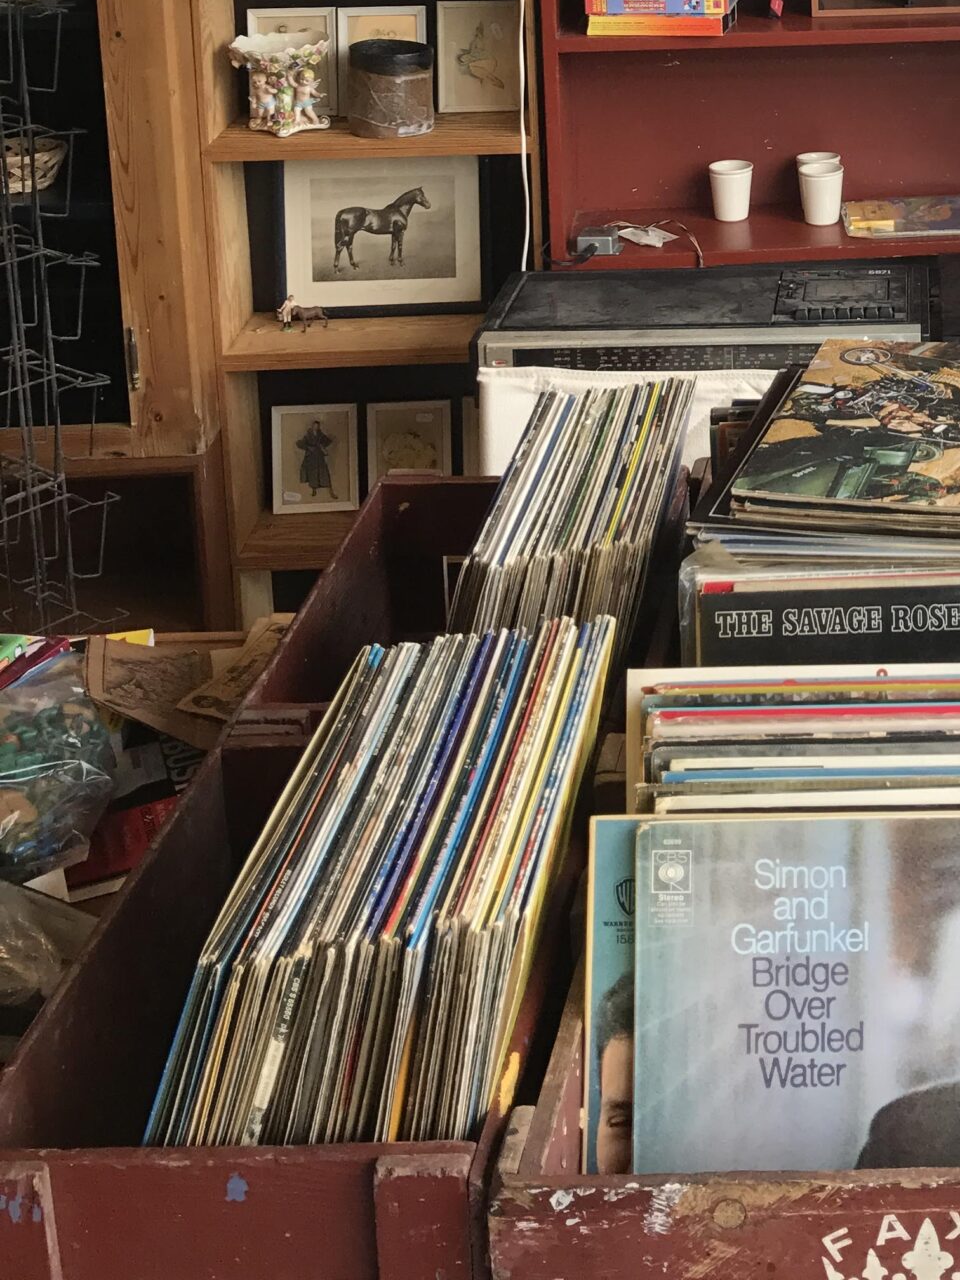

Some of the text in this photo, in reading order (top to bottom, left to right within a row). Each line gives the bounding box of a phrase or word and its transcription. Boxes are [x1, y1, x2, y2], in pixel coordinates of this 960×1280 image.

[715, 610, 773, 638] THE
[782, 606, 882, 636] SAVAGE
[656, 851, 688, 864] CBS
[754, 858, 847, 890] Simon
[658, 894, 684, 902] Stereo
[773, 889, 829, 920] and
[730, 920, 870, 955] Garfunkel
[752, 955, 849, 993] Bridge
[764, 989, 836, 1021] Over
[737, 1021, 864, 1055] Troubled
[758, 1056, 847, 1089] Water
